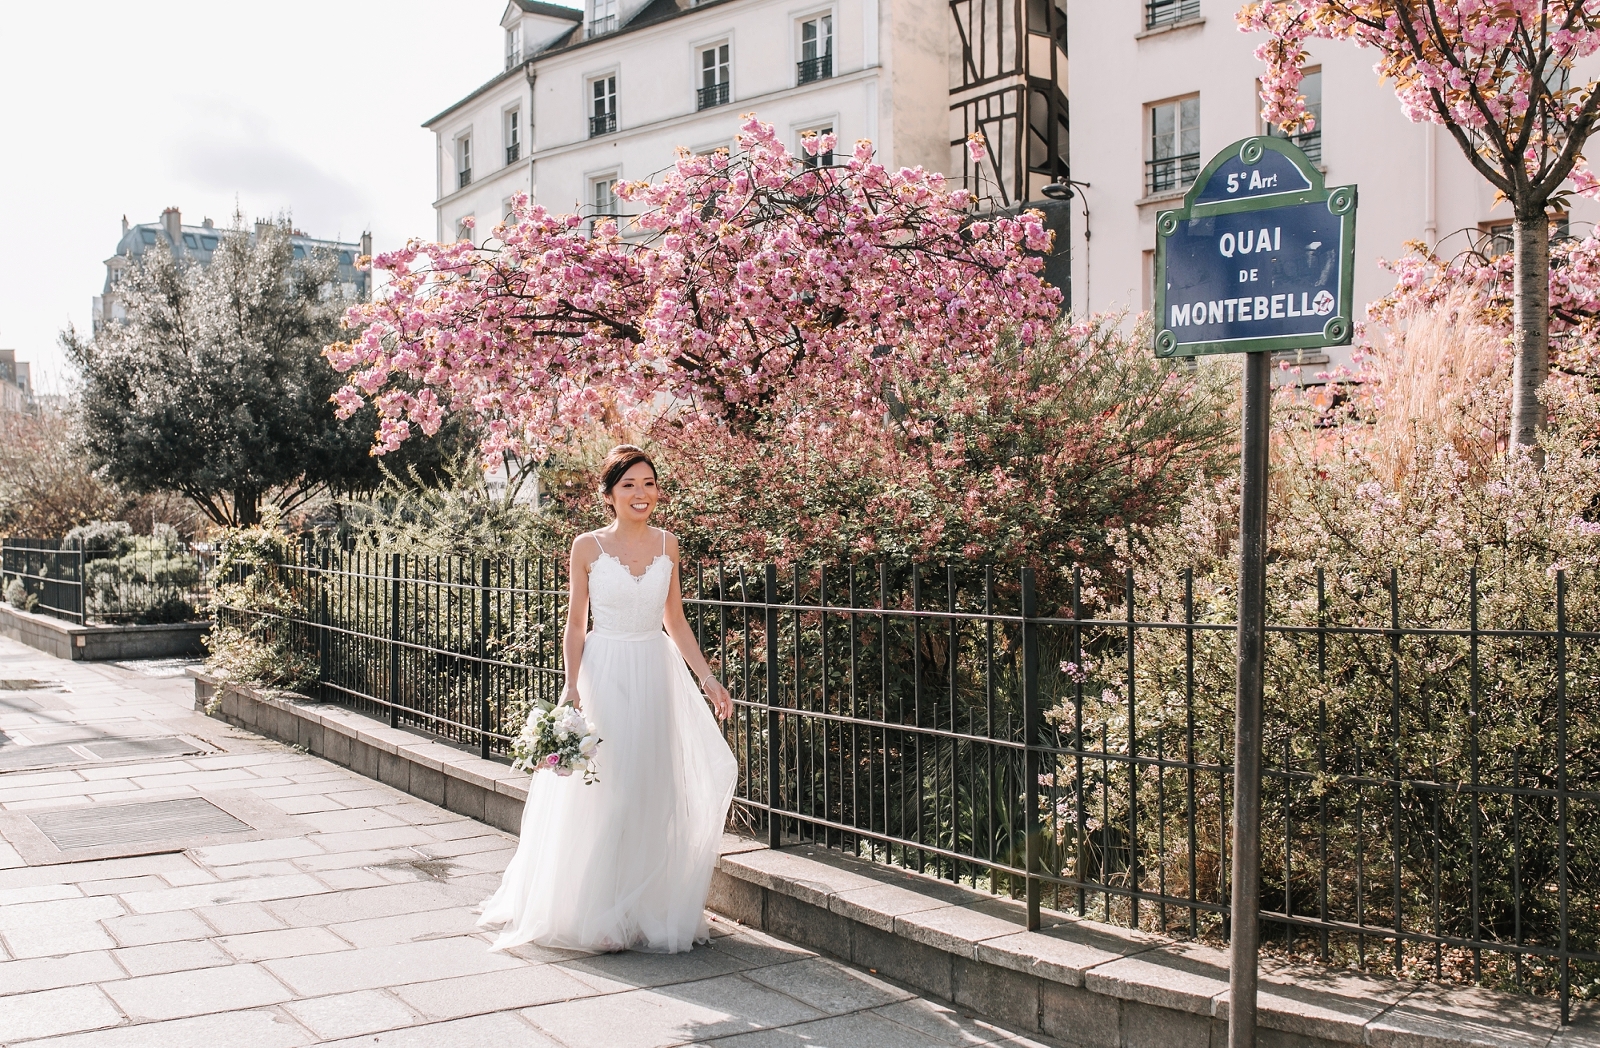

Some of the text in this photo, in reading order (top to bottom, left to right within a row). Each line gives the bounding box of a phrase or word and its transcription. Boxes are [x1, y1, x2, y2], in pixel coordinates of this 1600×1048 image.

[1219, 226, 1281, 258] QUAI
[1239, 268, 1259, 283] DE
[1171, 290, 1334, 328] MONTEBELL
